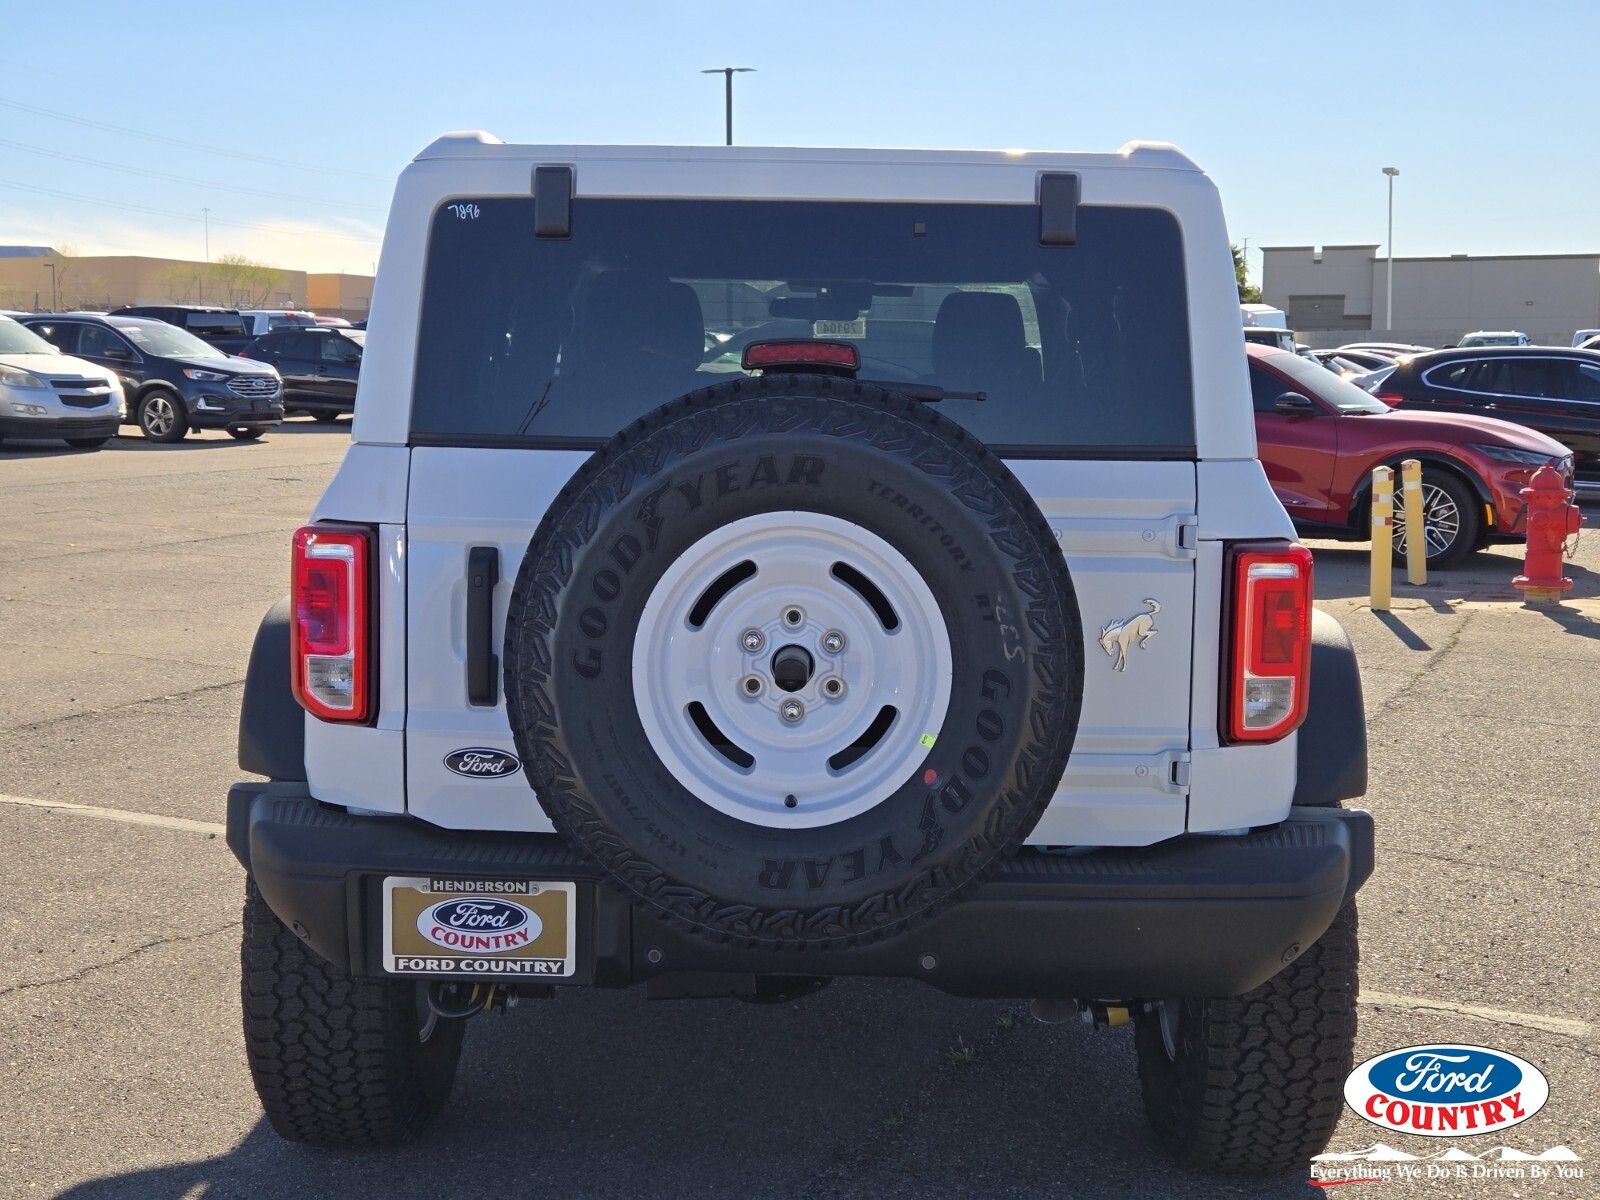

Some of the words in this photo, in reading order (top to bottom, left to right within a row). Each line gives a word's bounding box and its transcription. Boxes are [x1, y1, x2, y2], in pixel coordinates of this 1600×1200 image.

[447, 204, 480, 219] 7896
[867, 478, 976, 573] TERRITORY
[458, 751, 505, 774] Ford
[433, 880, 527, 893] HENDERSON
[449, 902, 511, 928] Ford
[430, 925, 529, 950] COUNTRY
[397, 958, 455, 971] FORD
[459, 959, 562, 974] COUNTRY
